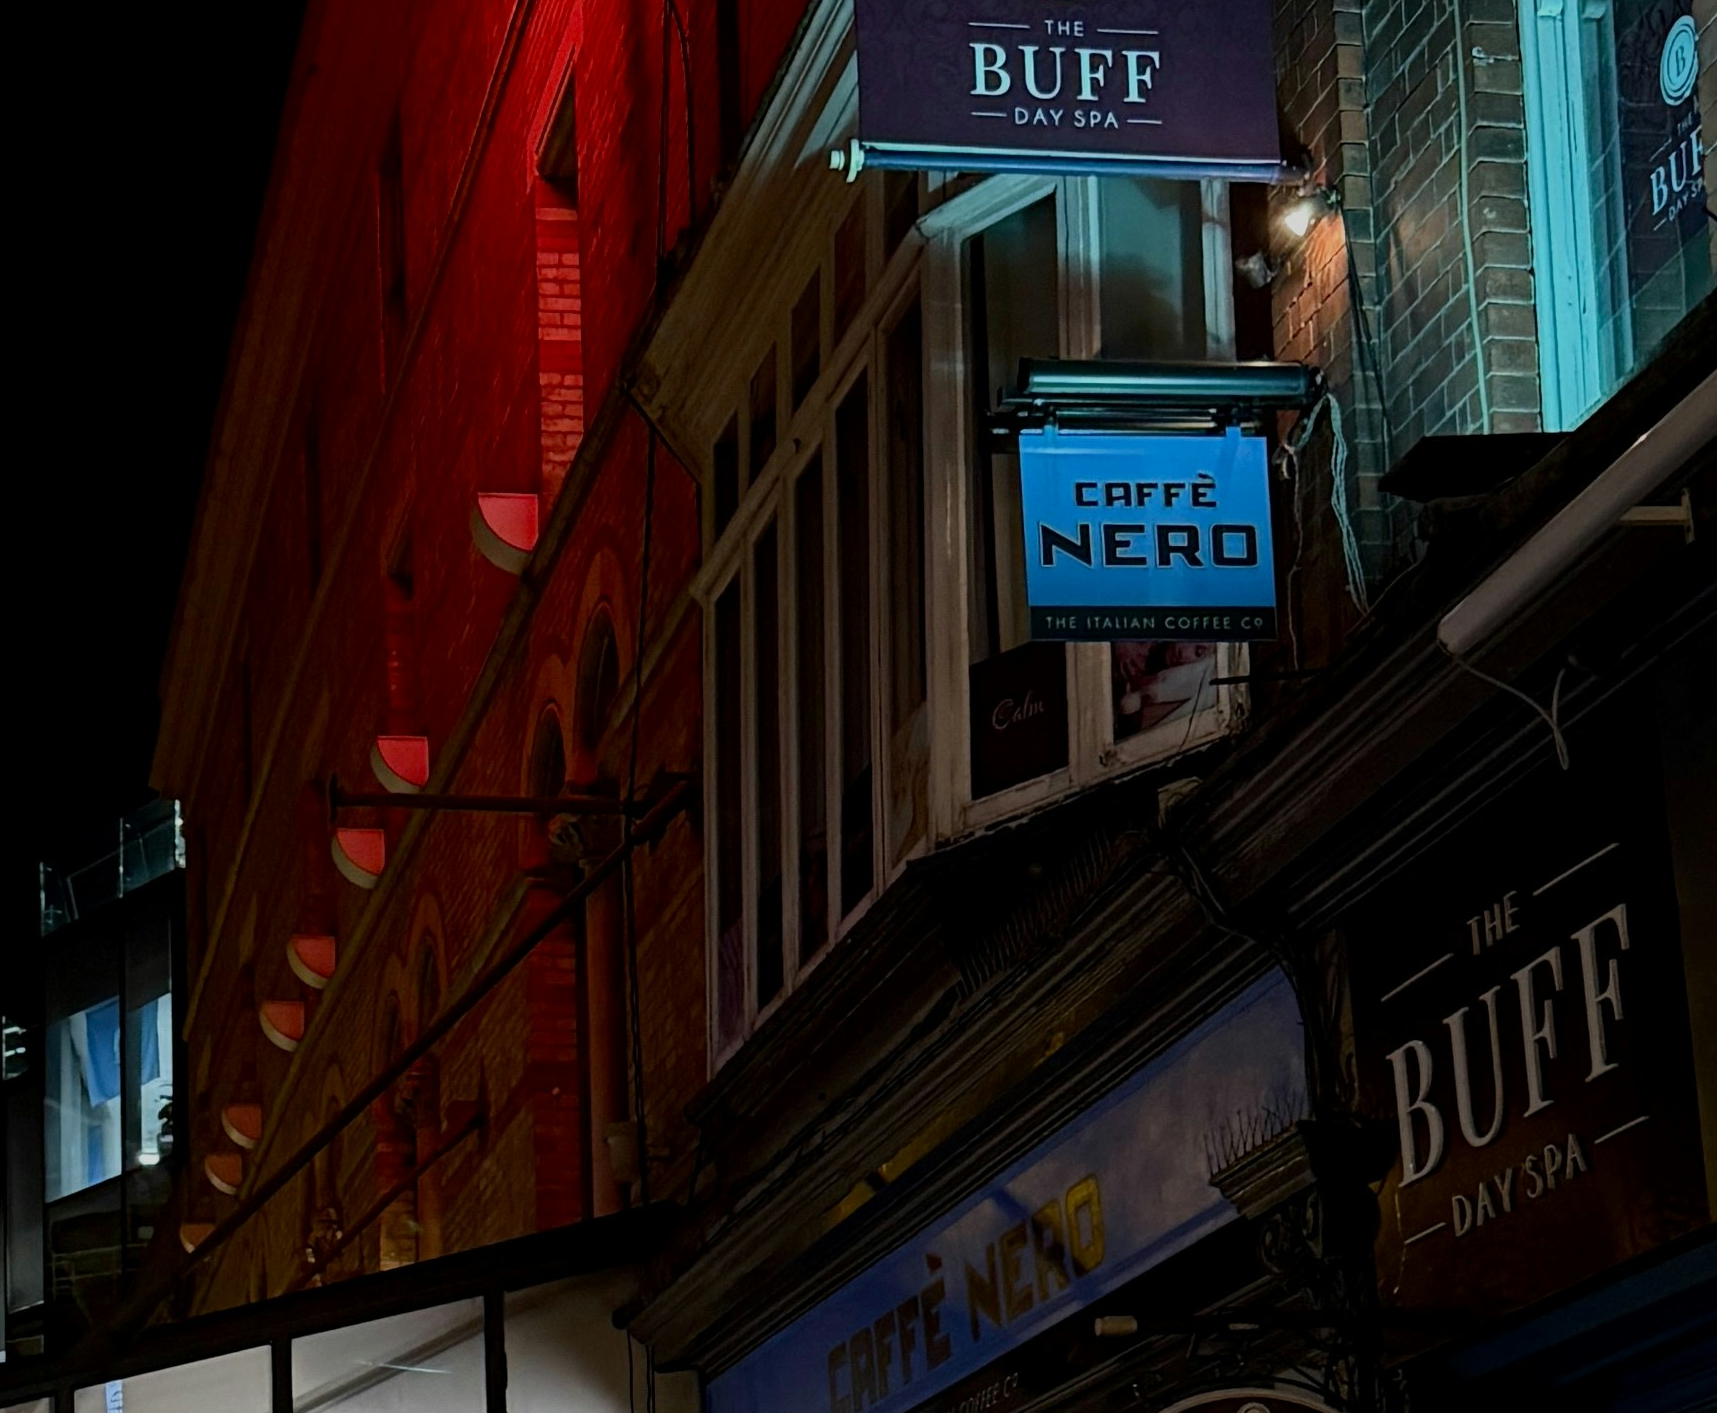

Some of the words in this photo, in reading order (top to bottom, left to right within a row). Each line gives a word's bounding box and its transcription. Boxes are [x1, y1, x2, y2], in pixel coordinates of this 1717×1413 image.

[1044, 17, 1085, 37] THE
[968, 42, 1163, 105] BUFF
[1013, 107, 1065, 128] DAY
[1073, 110, 1120, 130] SPA
[1649, 124, 1703, 216] BUF
[1074, 473, 1218, 509] CAFFÈ
[1040, 523, 1260, 569] NERO
[1045, 616, 1077, 629] THE
[1086, 616, 1156, 629] ITALIAN
[1164, 617, 1232, 629] COFFEE
[1465, 889, 1521, 957] THE
[1385, 901, 1632, 1189] BUFF
[1452, 1166, 1515, 1239] DAY
[1525, 1132, 1590, 1200] SPA
[965, 1174, 1106, 1344] NERO
